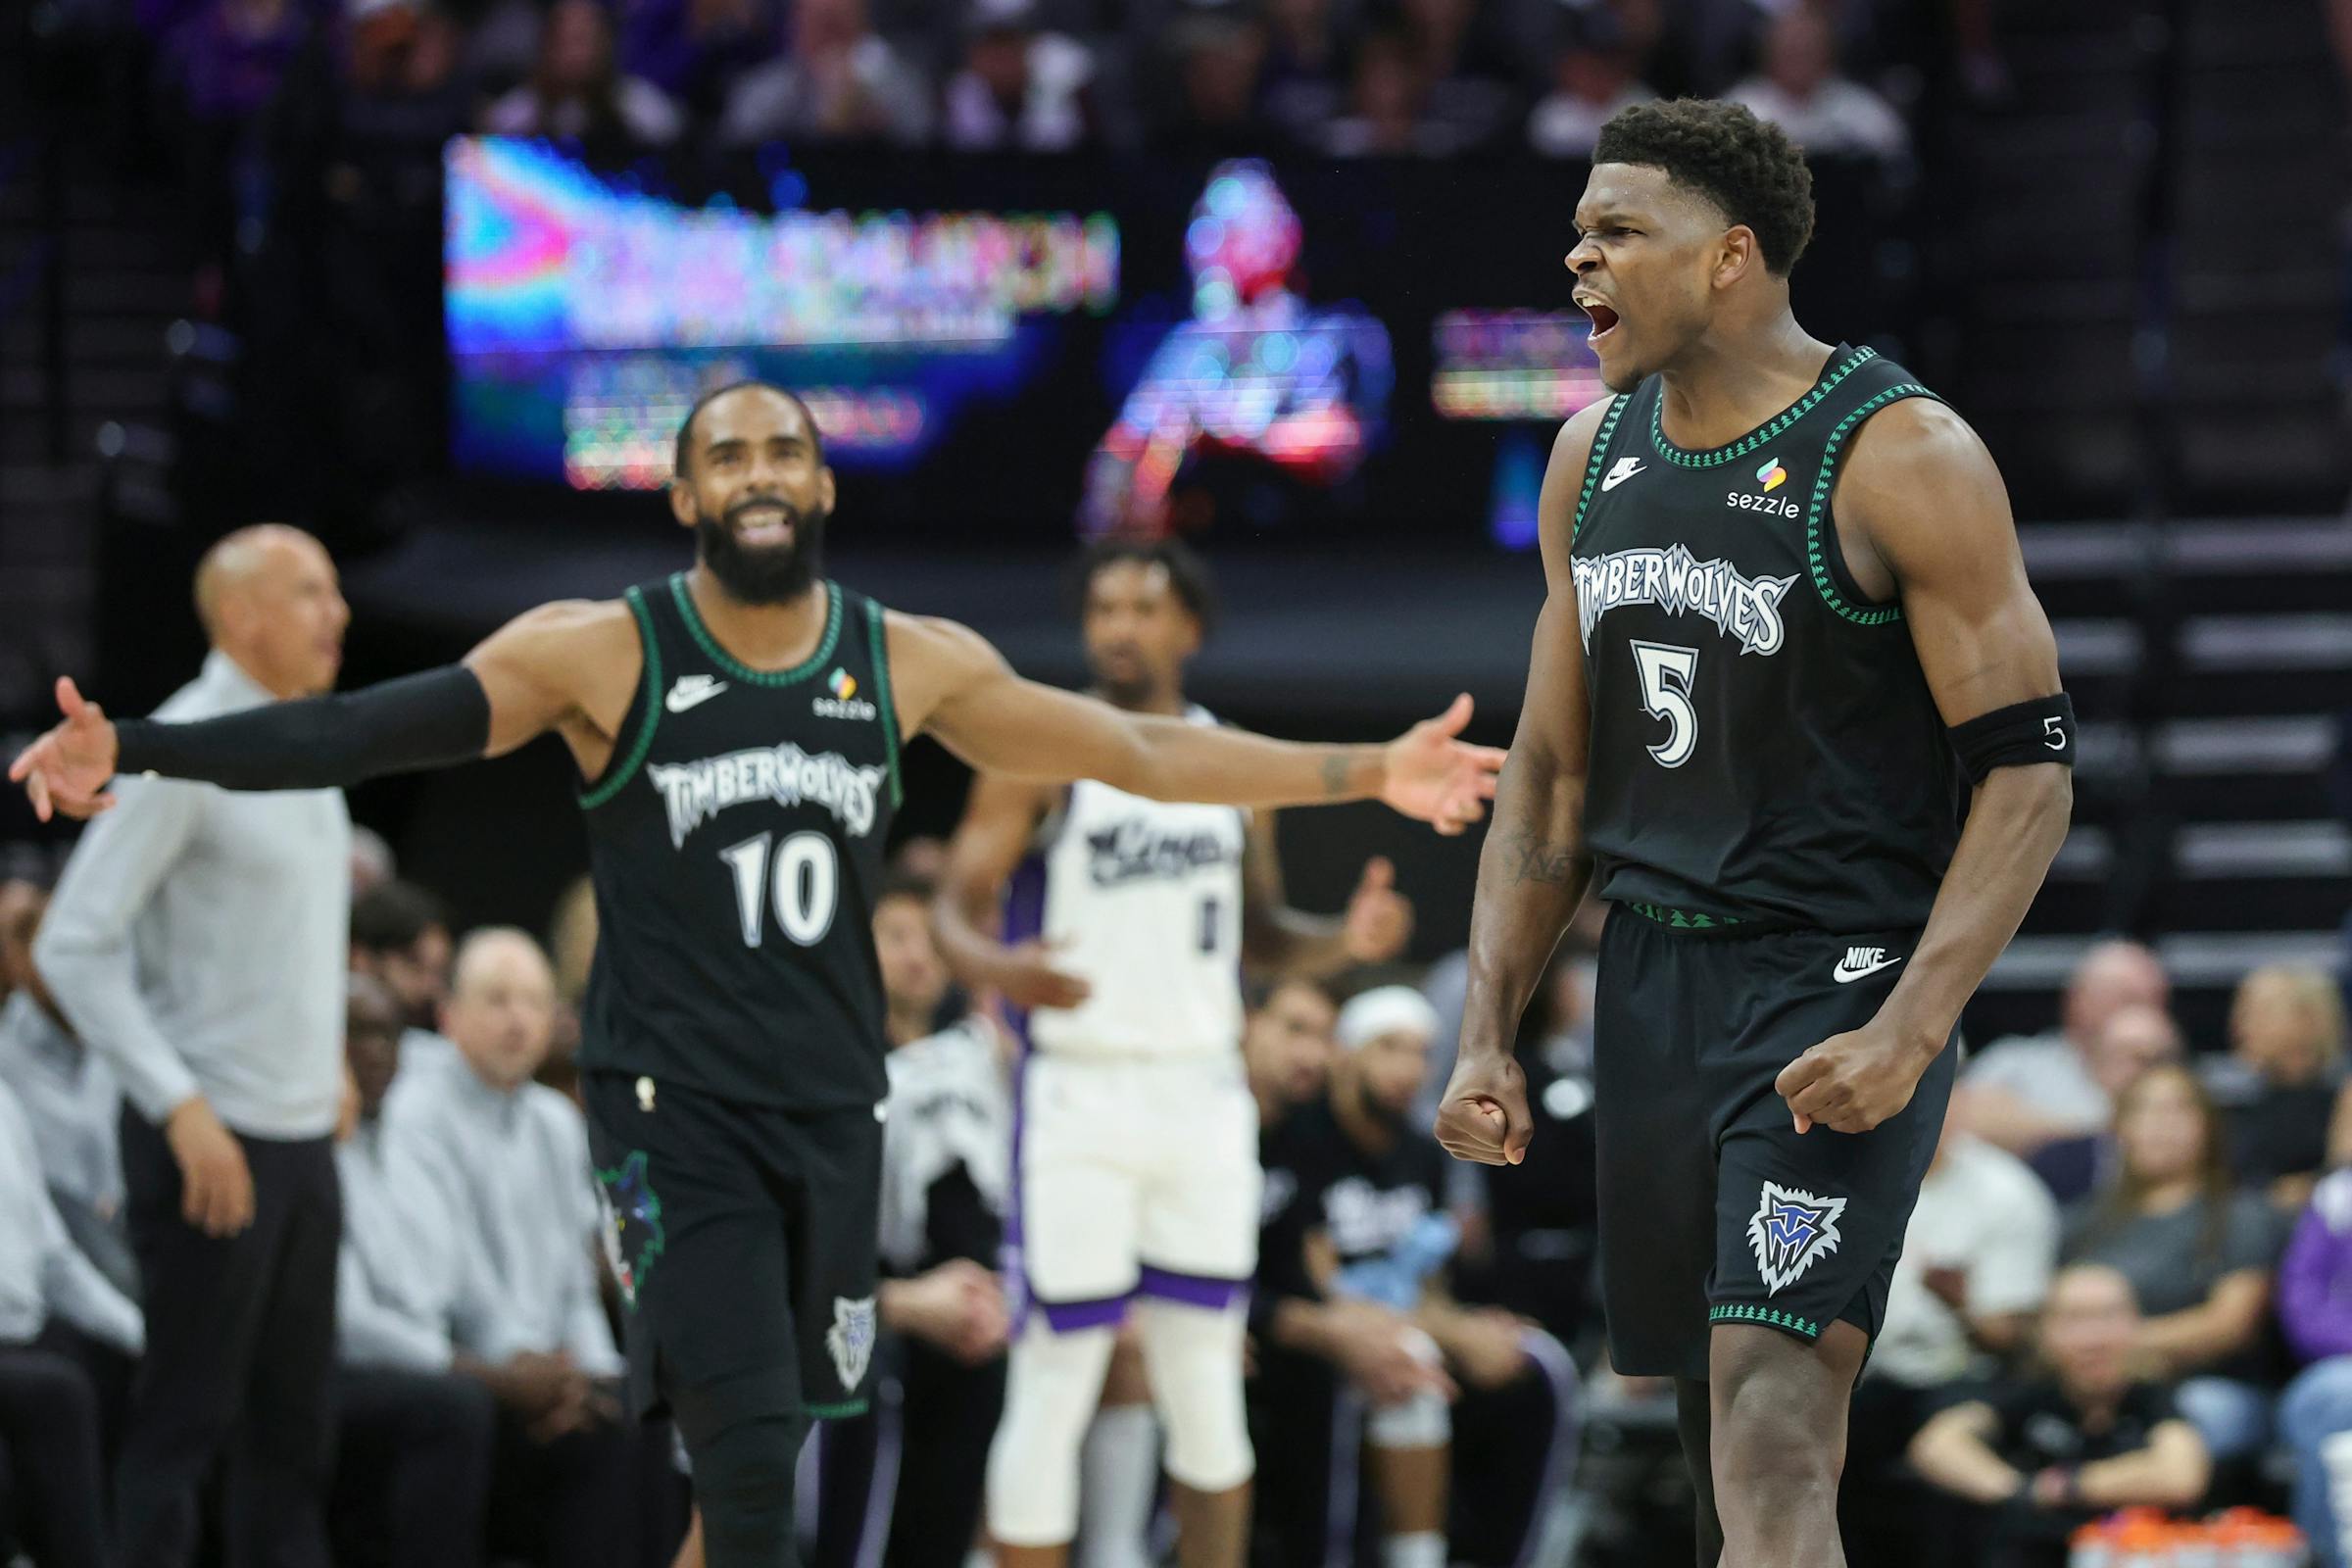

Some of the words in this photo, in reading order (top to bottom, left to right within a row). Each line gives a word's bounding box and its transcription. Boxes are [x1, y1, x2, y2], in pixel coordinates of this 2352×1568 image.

[1726, 491, 1800, 519] sezzle
[1570, 543, 1802, 657] TIMBERWOLVES
[1629, 638, 1700, 769] 5
[2043, 715, 2067, 751] 5
[646, 741, 890, 852] TIMBERWOLVES
[717, 829, 840, 949] 10
[1842, 947, 1886, 969] NIKE
